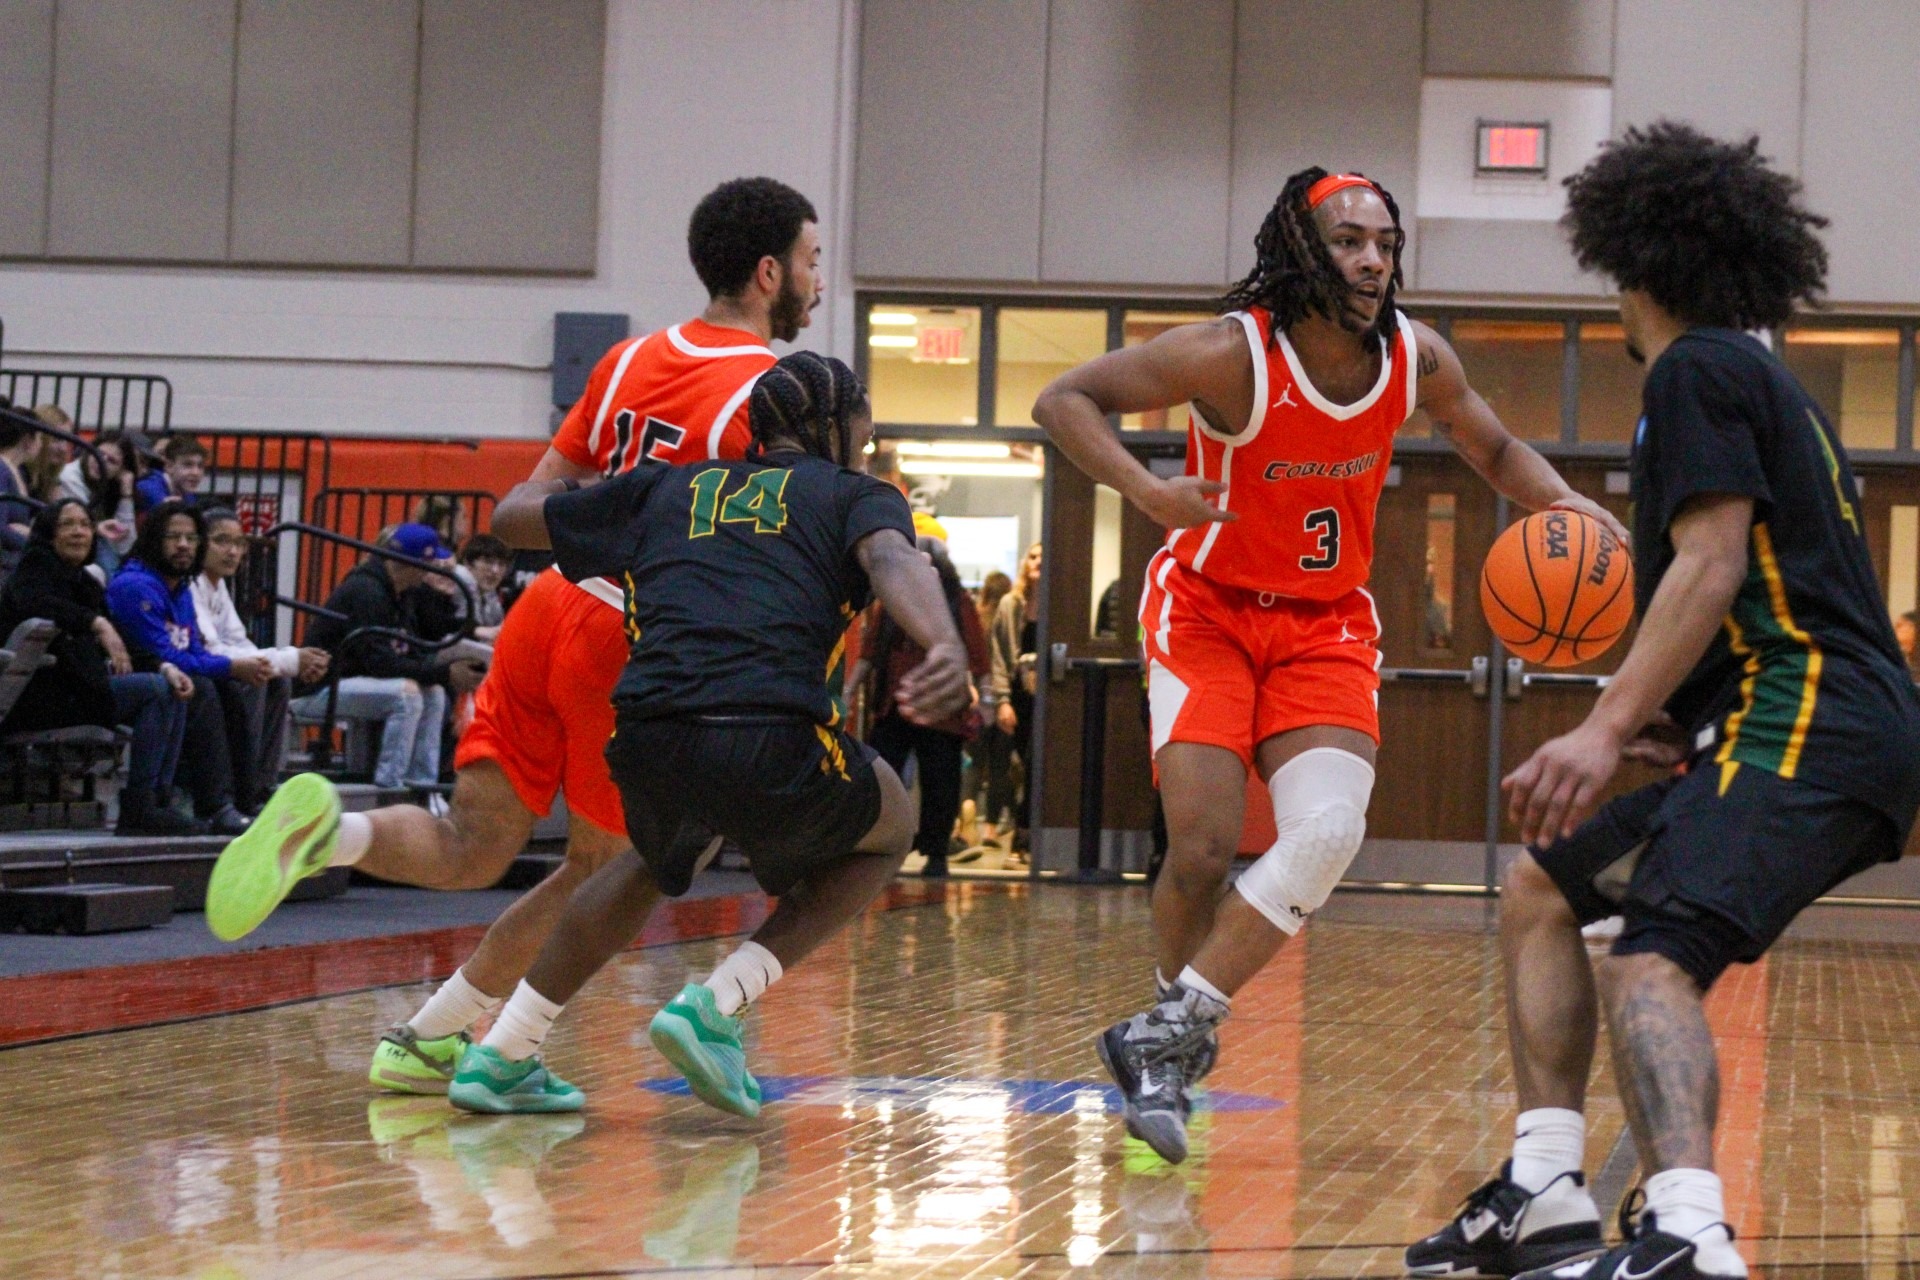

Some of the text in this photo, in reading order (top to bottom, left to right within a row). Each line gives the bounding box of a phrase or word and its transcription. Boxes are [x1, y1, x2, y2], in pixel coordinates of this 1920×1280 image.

[923, 328, 964, 358] EXIT
[1263, 451, 1382, 482] COBLESKI
[688, 467, 793, 540] 14
[1298, 506, 1341, 571] 3
[1587, 526, 1619, 586] lson
